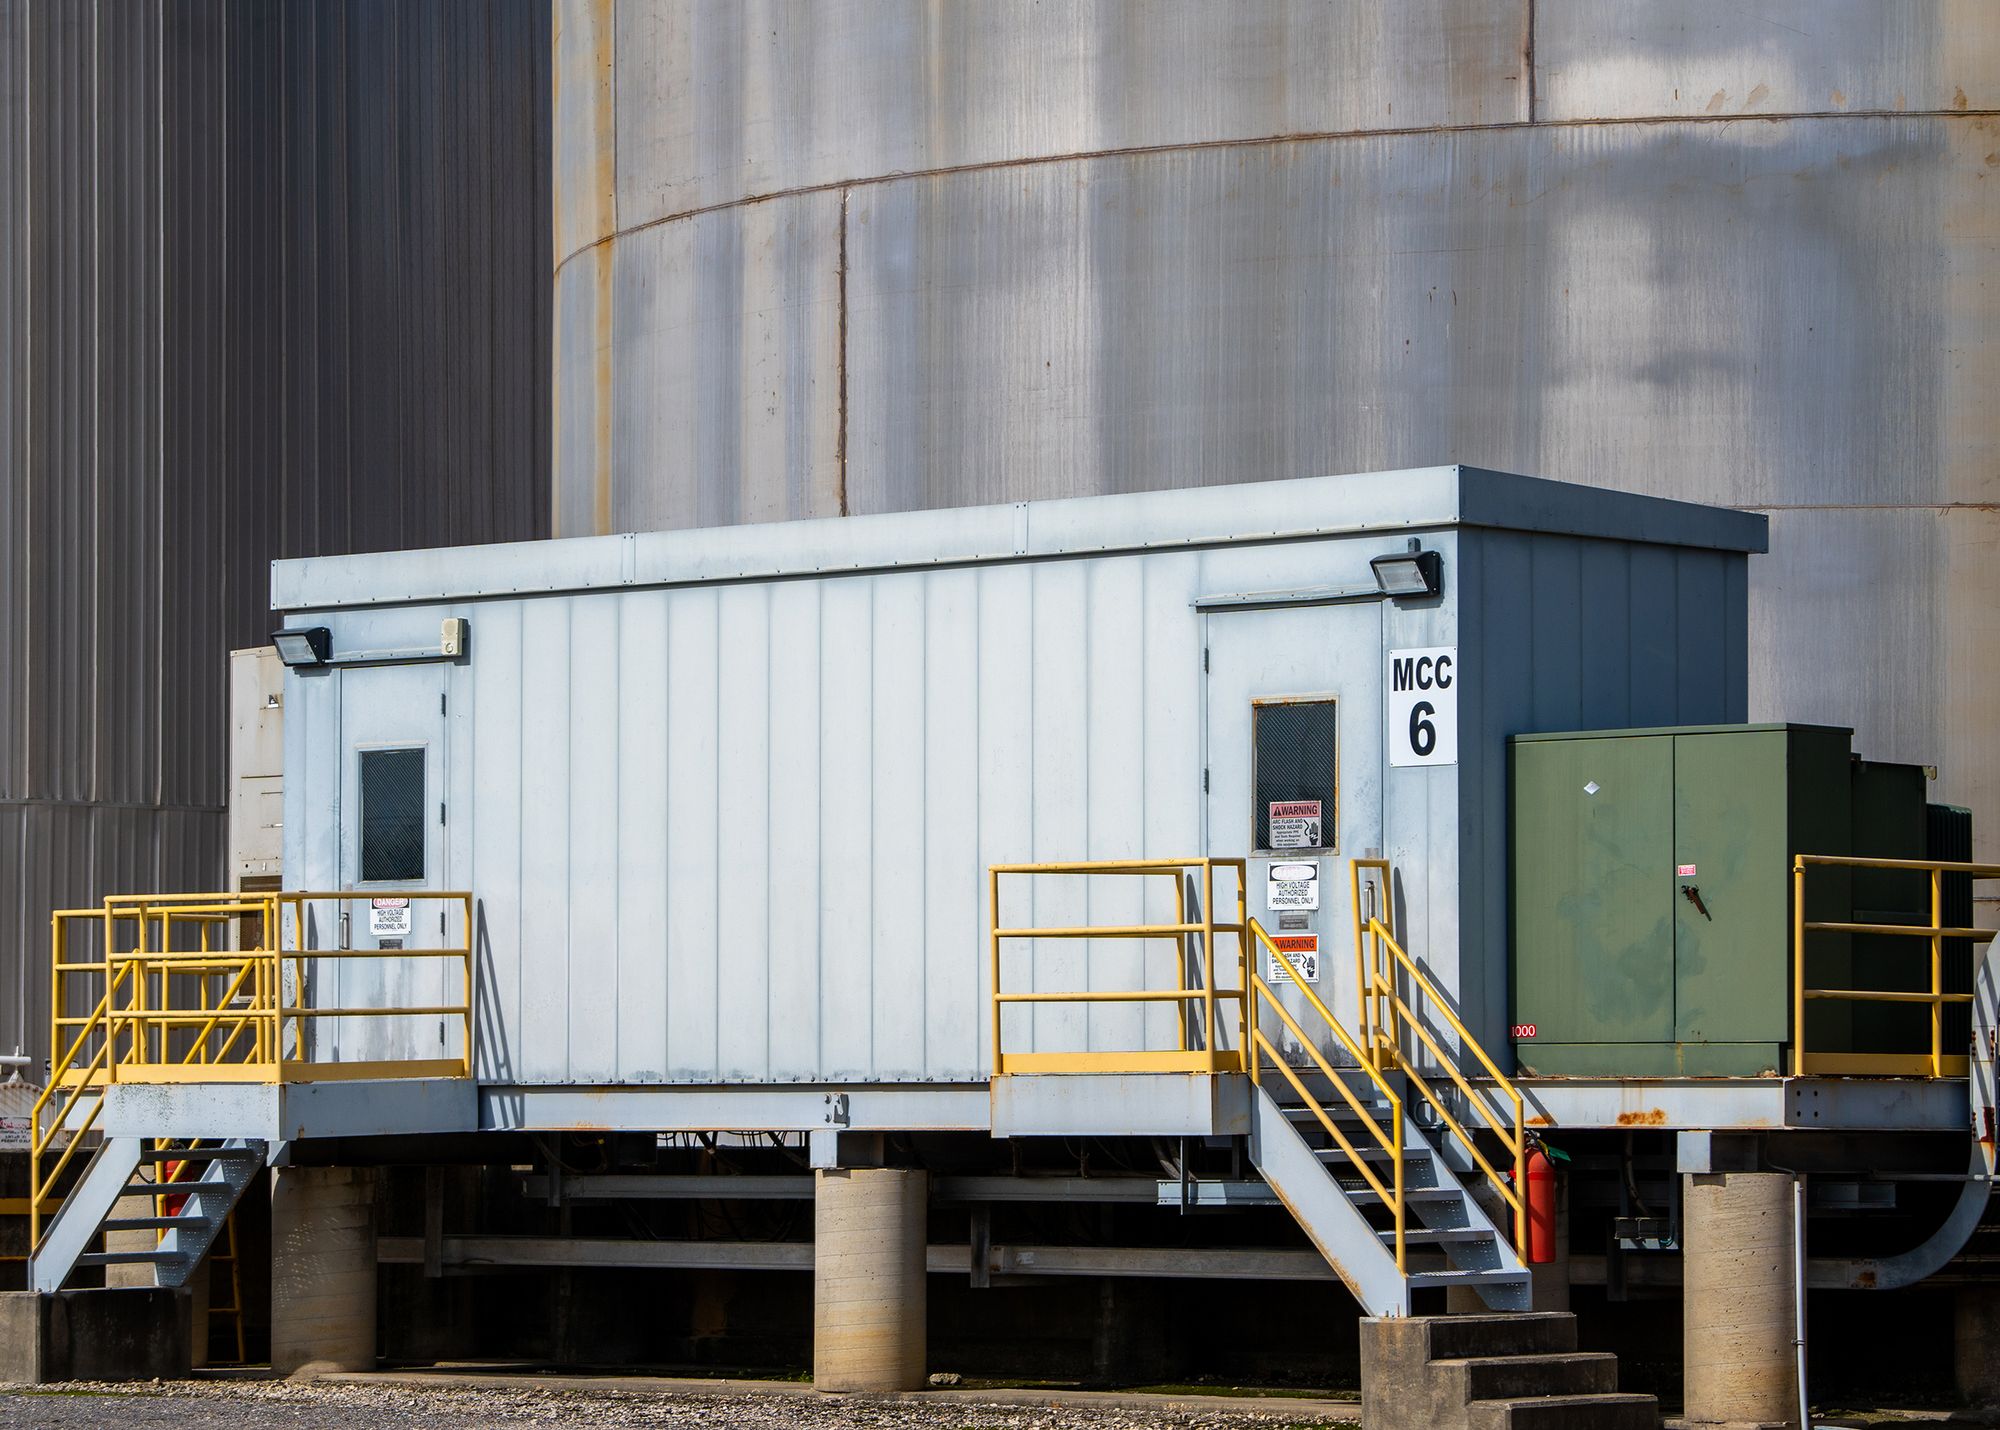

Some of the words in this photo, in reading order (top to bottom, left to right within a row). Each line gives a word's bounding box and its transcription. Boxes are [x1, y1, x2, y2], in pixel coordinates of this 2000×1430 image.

[1393, 655, 1453, 692] MCC
[1409, 700, 1437, 757] 6
[1281, 805, 1318, 816] WARNING
[1276, 881, 1287, 889] HIGH
[1289, 881, 1310, 889] VOLTAGE
[378, 898, 406, 906] DANGER
[1280, 939, 1315, 949] WARNING
[1511, 1025, 1536, 1037] 1000
